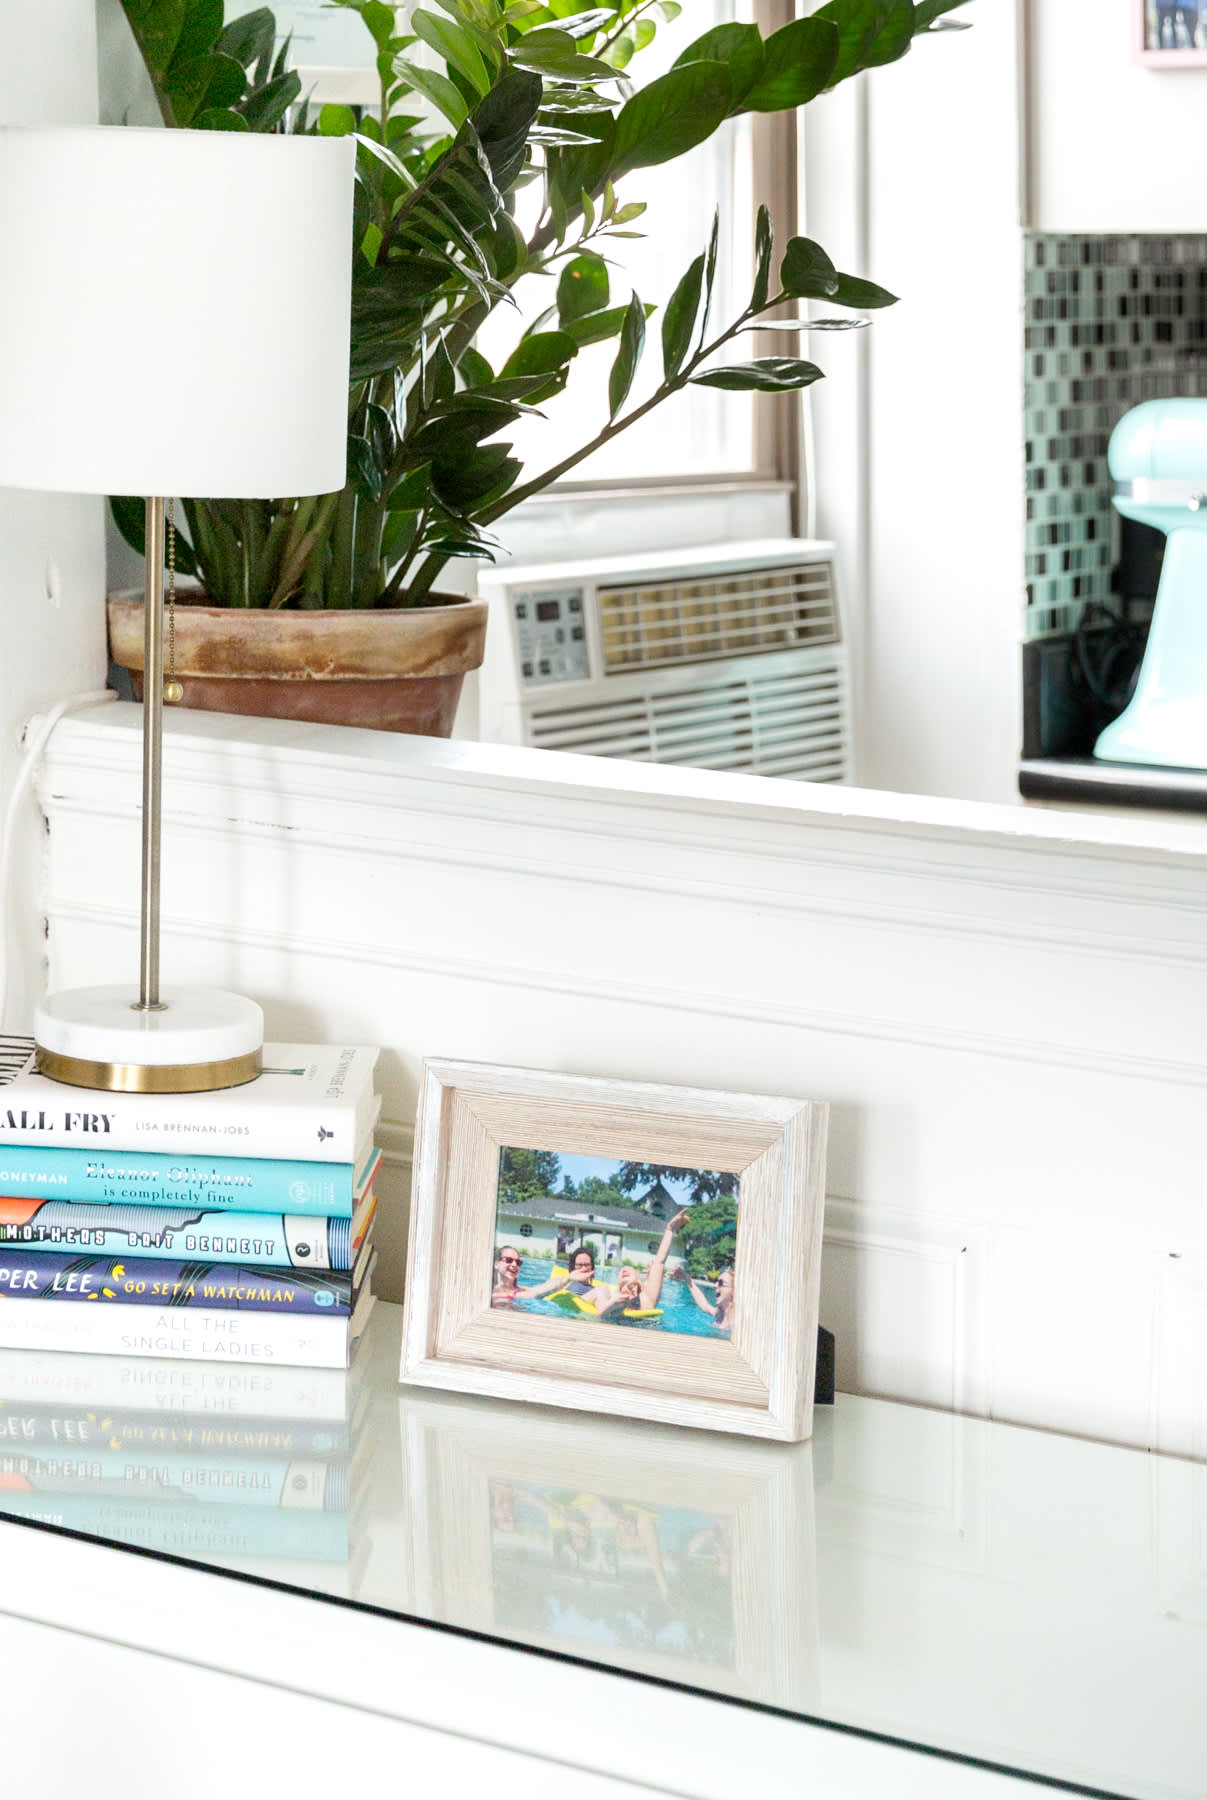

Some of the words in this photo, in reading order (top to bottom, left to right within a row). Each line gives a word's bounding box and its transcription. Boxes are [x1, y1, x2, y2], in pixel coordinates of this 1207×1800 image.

[64, 1112, 116, 1133] FRY
[135, 1122, 159, 1131] LISA
[164, 1123, 250, 1135] BRENNAN-JOBS
[86, 1163, 160, 1182] Eleanor
[167, 1167, 253, 1189] Oliphant
[104, 1185, 115, 1197] is
[121, 1188, 201, 1204] completely
[207, 1191, 235, 1203] fine
[5, 1224, 106, 1246] MOTHERS
[128, 1232, 174, 1249] BRIT
[185, 1235, 276, 1255] BENNETT
[52, 1272, 94, 1293] LEE
[123, 1280, 146, 1294] GO
[151, 1282, 181, 1296] SET
[184, 1284, 195, 1297] A
[203, 1285, 296, 1303] WATCHMAN
[155, 1315, 192, 1331] ALL
[201, 1317, 241, 1334] THE
[121, 1335, 192, 1352] SINGLE
[202, 1339, 274, 1357] LADIES
